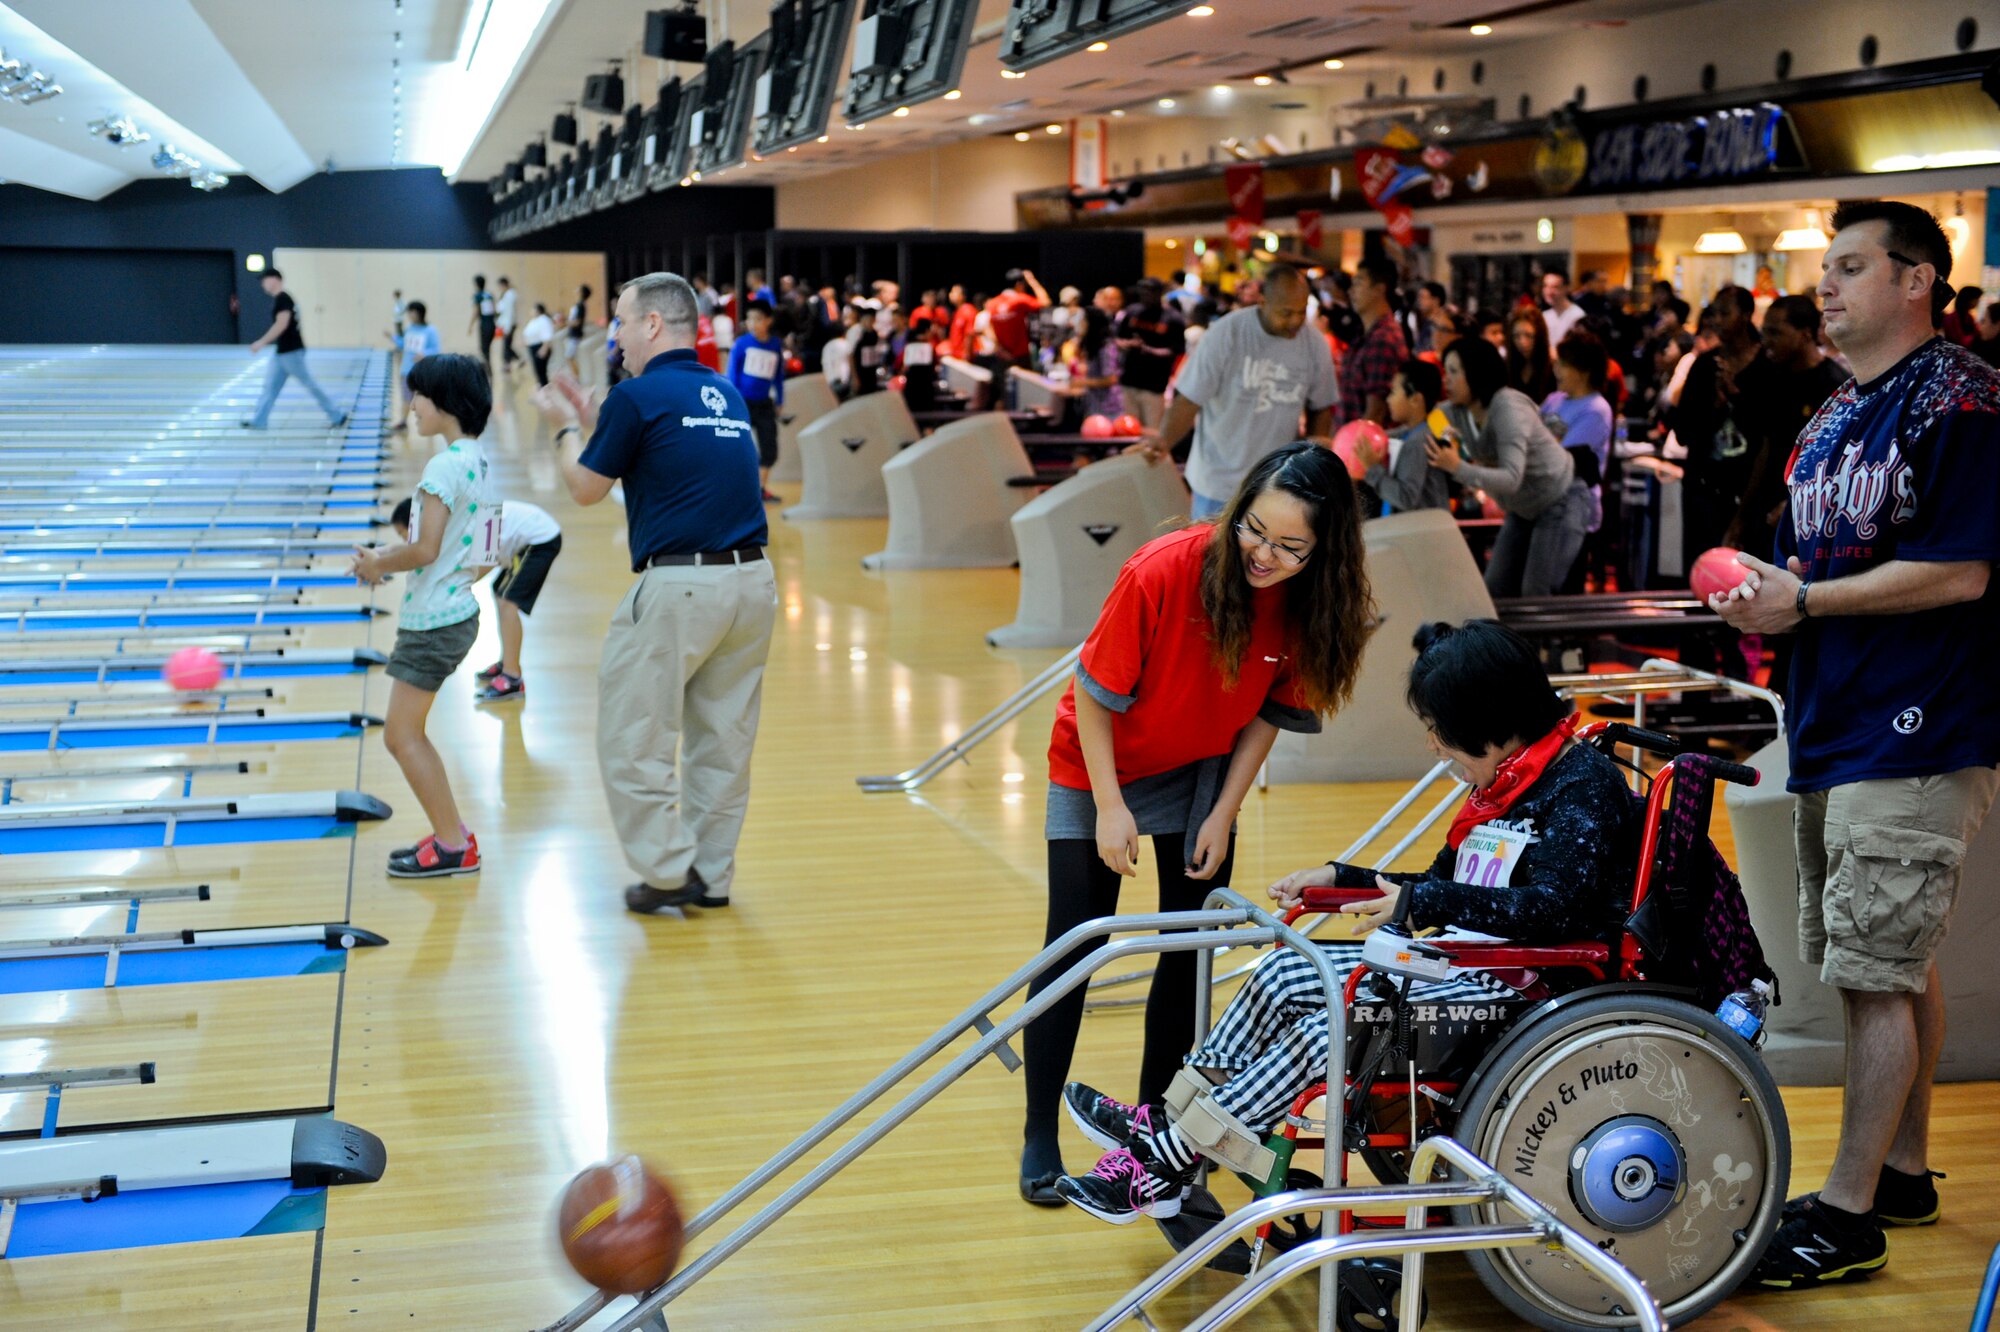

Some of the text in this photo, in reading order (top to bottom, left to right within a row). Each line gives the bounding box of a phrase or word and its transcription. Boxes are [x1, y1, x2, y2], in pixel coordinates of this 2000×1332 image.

[682, 416, 719, 428] Special
[1465, 838, 1498, 853] BOWLING
[1515, 1060, 1639, 1177] Mickey & Pluto
